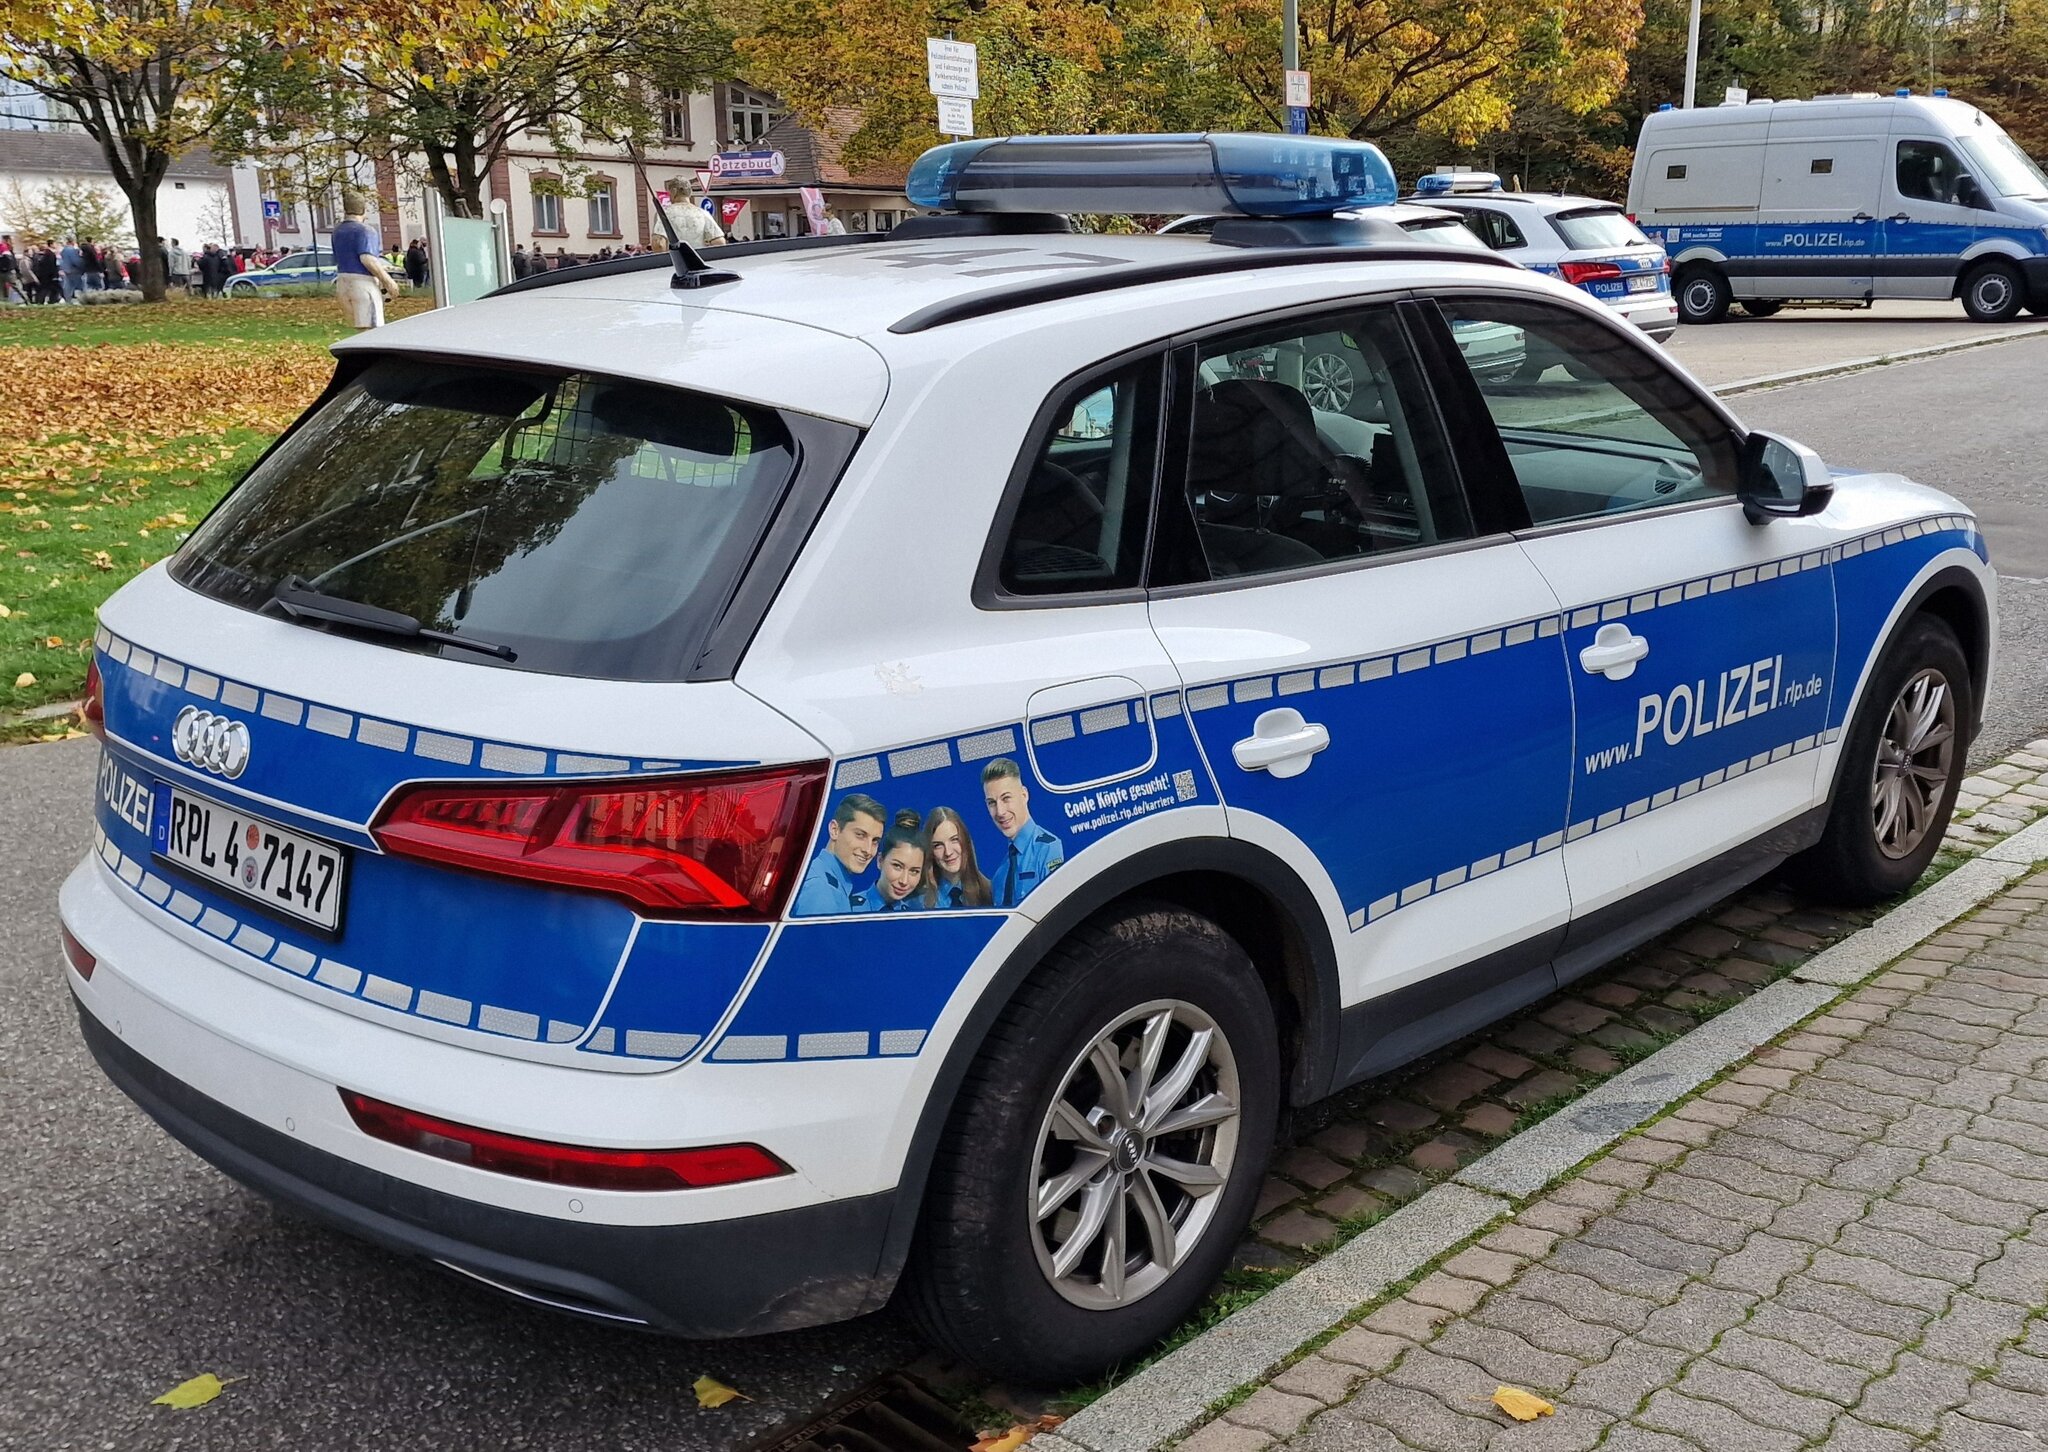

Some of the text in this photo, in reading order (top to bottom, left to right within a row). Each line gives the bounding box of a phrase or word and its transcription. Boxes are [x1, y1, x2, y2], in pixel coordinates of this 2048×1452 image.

[712, 157, 772, 174] Betzebud
[1595, 281, 1624, 294] POLIZEI
[1585, 653, 1823, 775] www.POLIZEI.rlp.de
[100, 750, 155, 837] POLIZEI
[1064, 772, 1171, 819] Coole Köpfe gesucht!
[1070, 794, 1175, 835] www.polizei.rlp.de/karriere
[157, 825, 165, 842] D
[170, 796, 336, 914] RPL 4 7147
